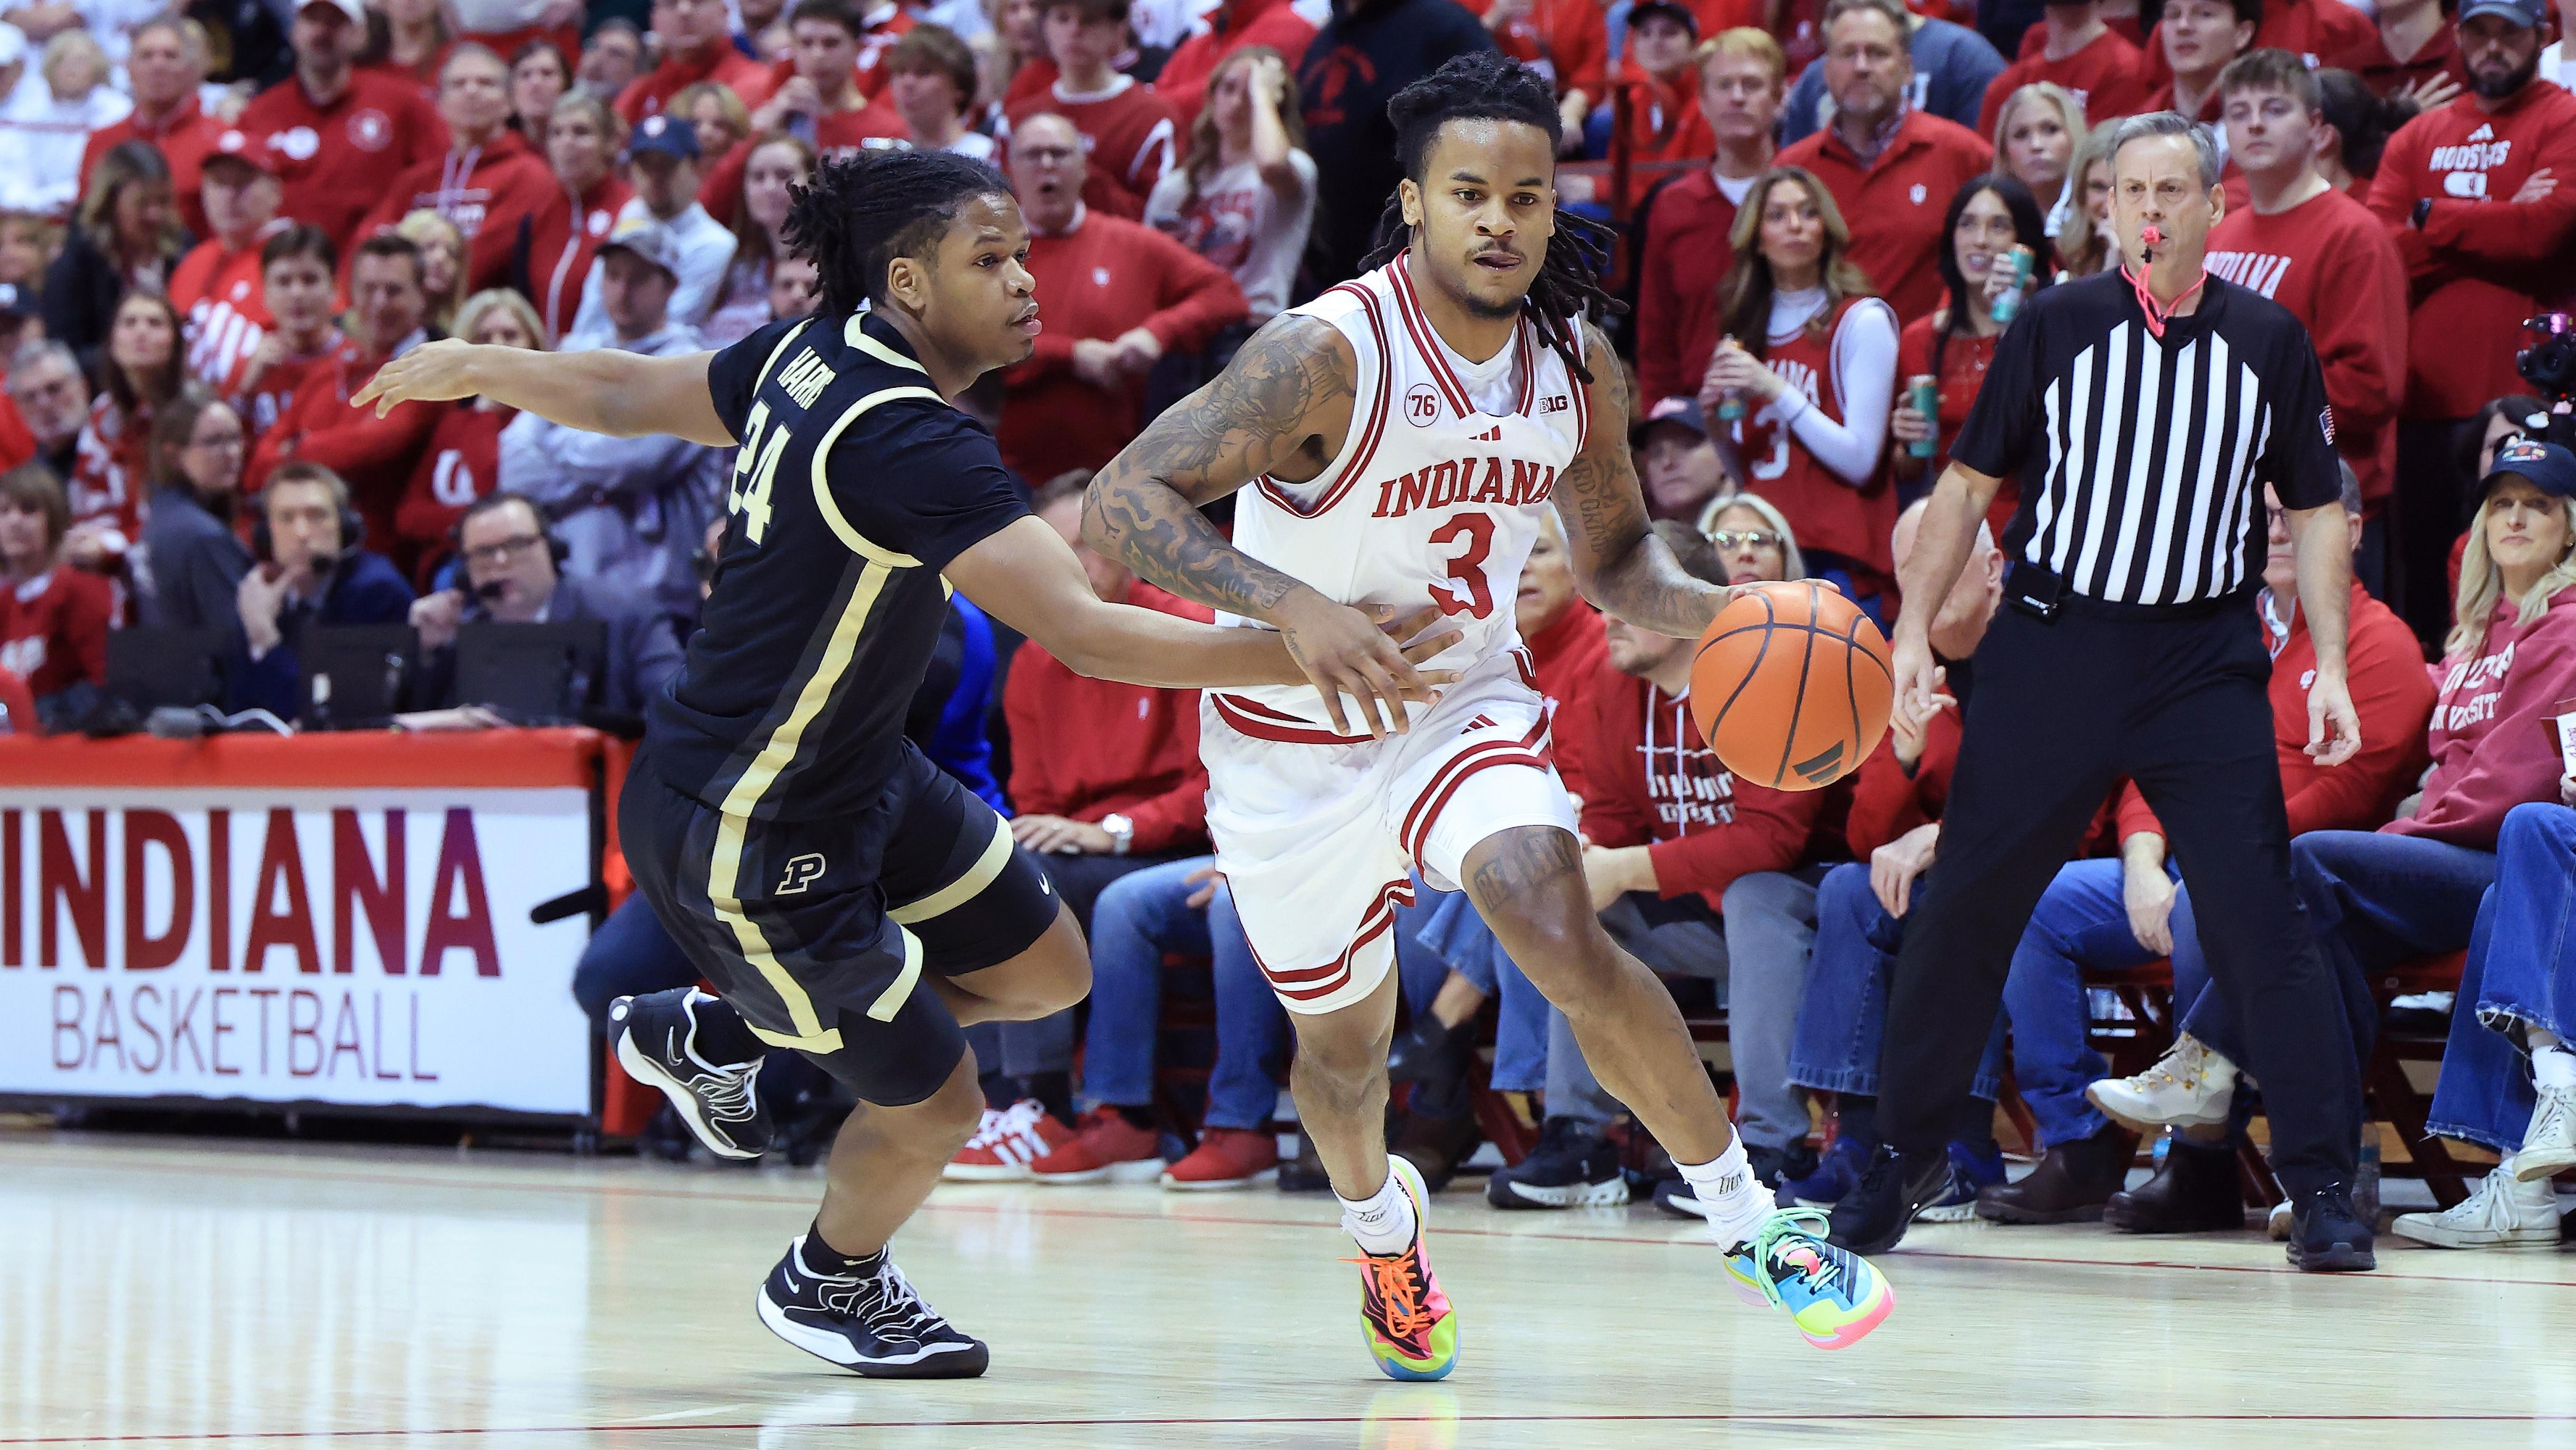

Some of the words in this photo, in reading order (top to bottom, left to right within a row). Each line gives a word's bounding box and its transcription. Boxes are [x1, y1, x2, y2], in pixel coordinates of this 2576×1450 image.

[728, 399, 792, 546] 24
[1371, 457, 1555, 518] INDIANA
[1750, 403, 1790, 480] 3
[1428, 512, 1495, 620] 3
[2, 808, 502, 977] INDIANA
[775, 853, 826, 895] P
[53, 985, 439, 1081] BASKETBALL
